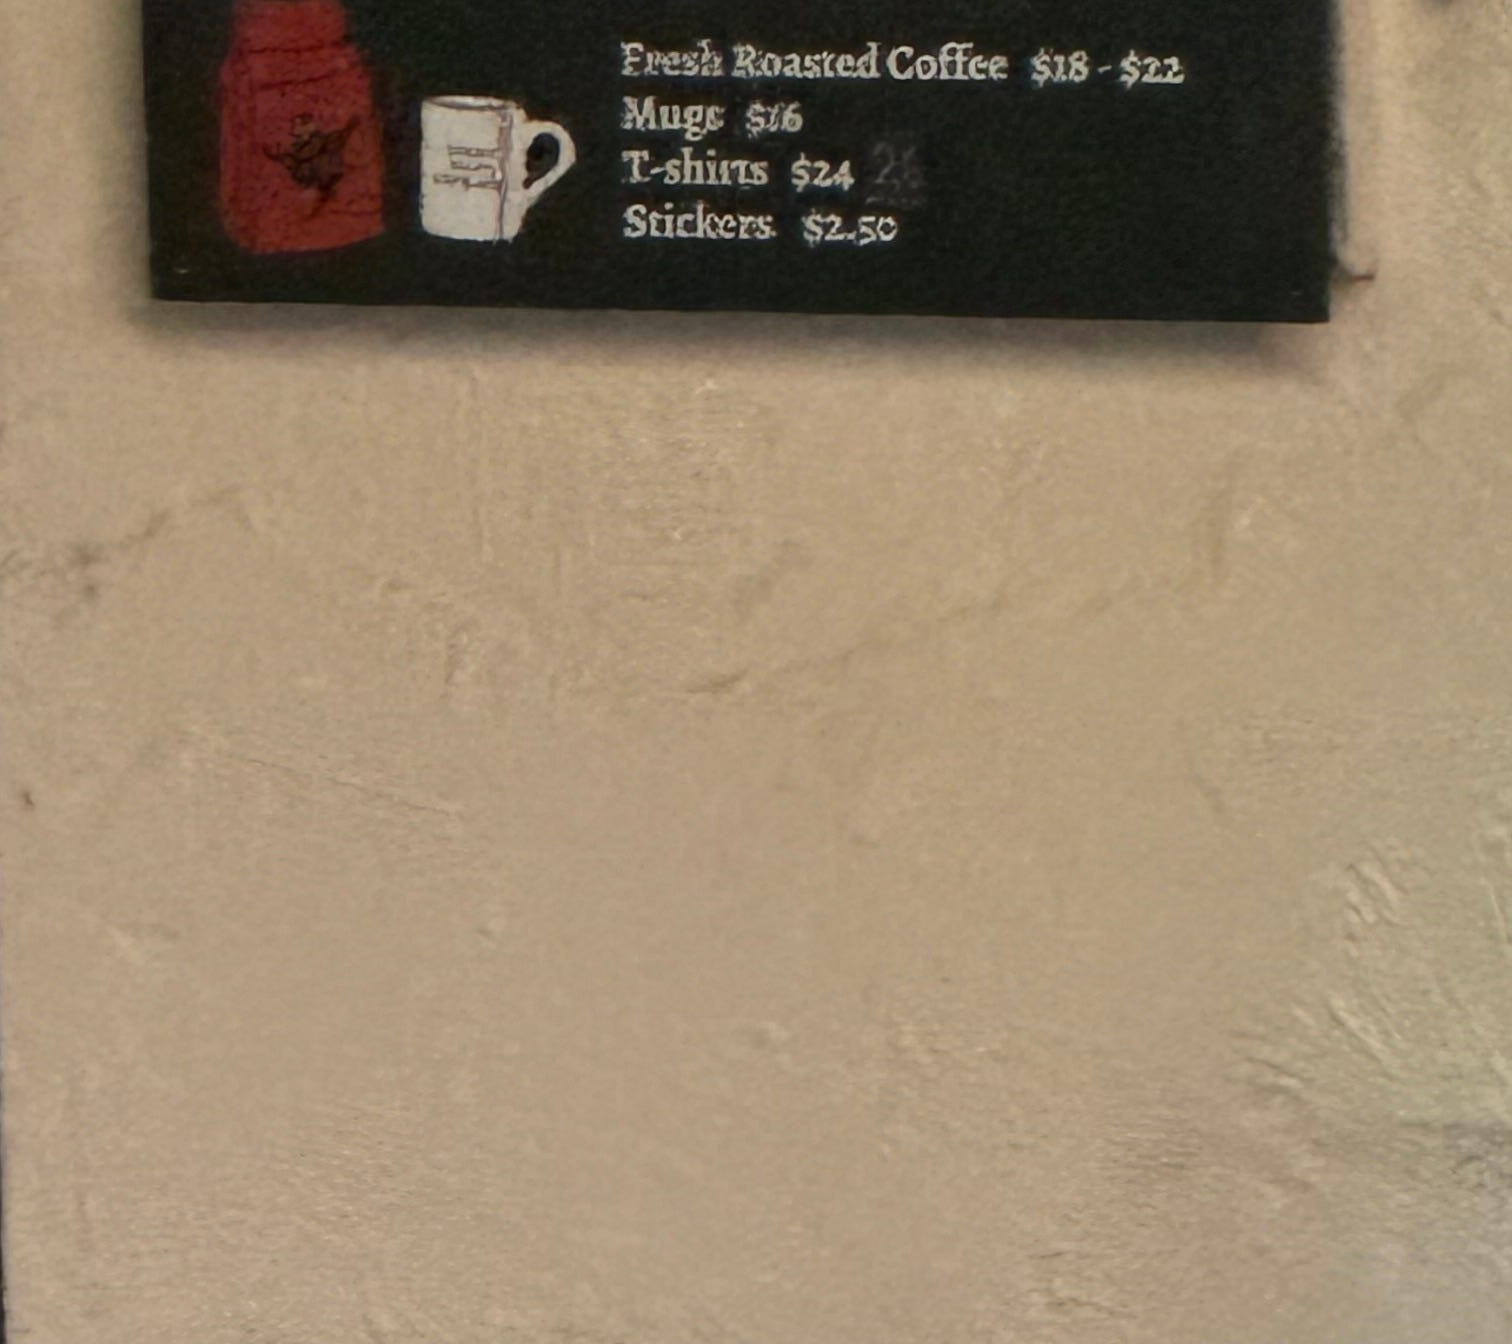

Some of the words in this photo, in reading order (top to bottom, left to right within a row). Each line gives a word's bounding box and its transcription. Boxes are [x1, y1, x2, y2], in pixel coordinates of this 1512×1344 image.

[620, 38, 724, 77] Fresh
[731, 41, 881, 80] Roasted
[885, 41, 1009, 81] Coffee
[1030, 47, 1090, 88] $18
[1119, 49, 1185, 89] $22
[620, 95, 725, 142] Mugs
[621, 146, 769, 186] T-shirts
[791, 152, 855, 193] $24
[623, 200, 777, 240] Stickers
[801, 213, 898, 246] $2.50
